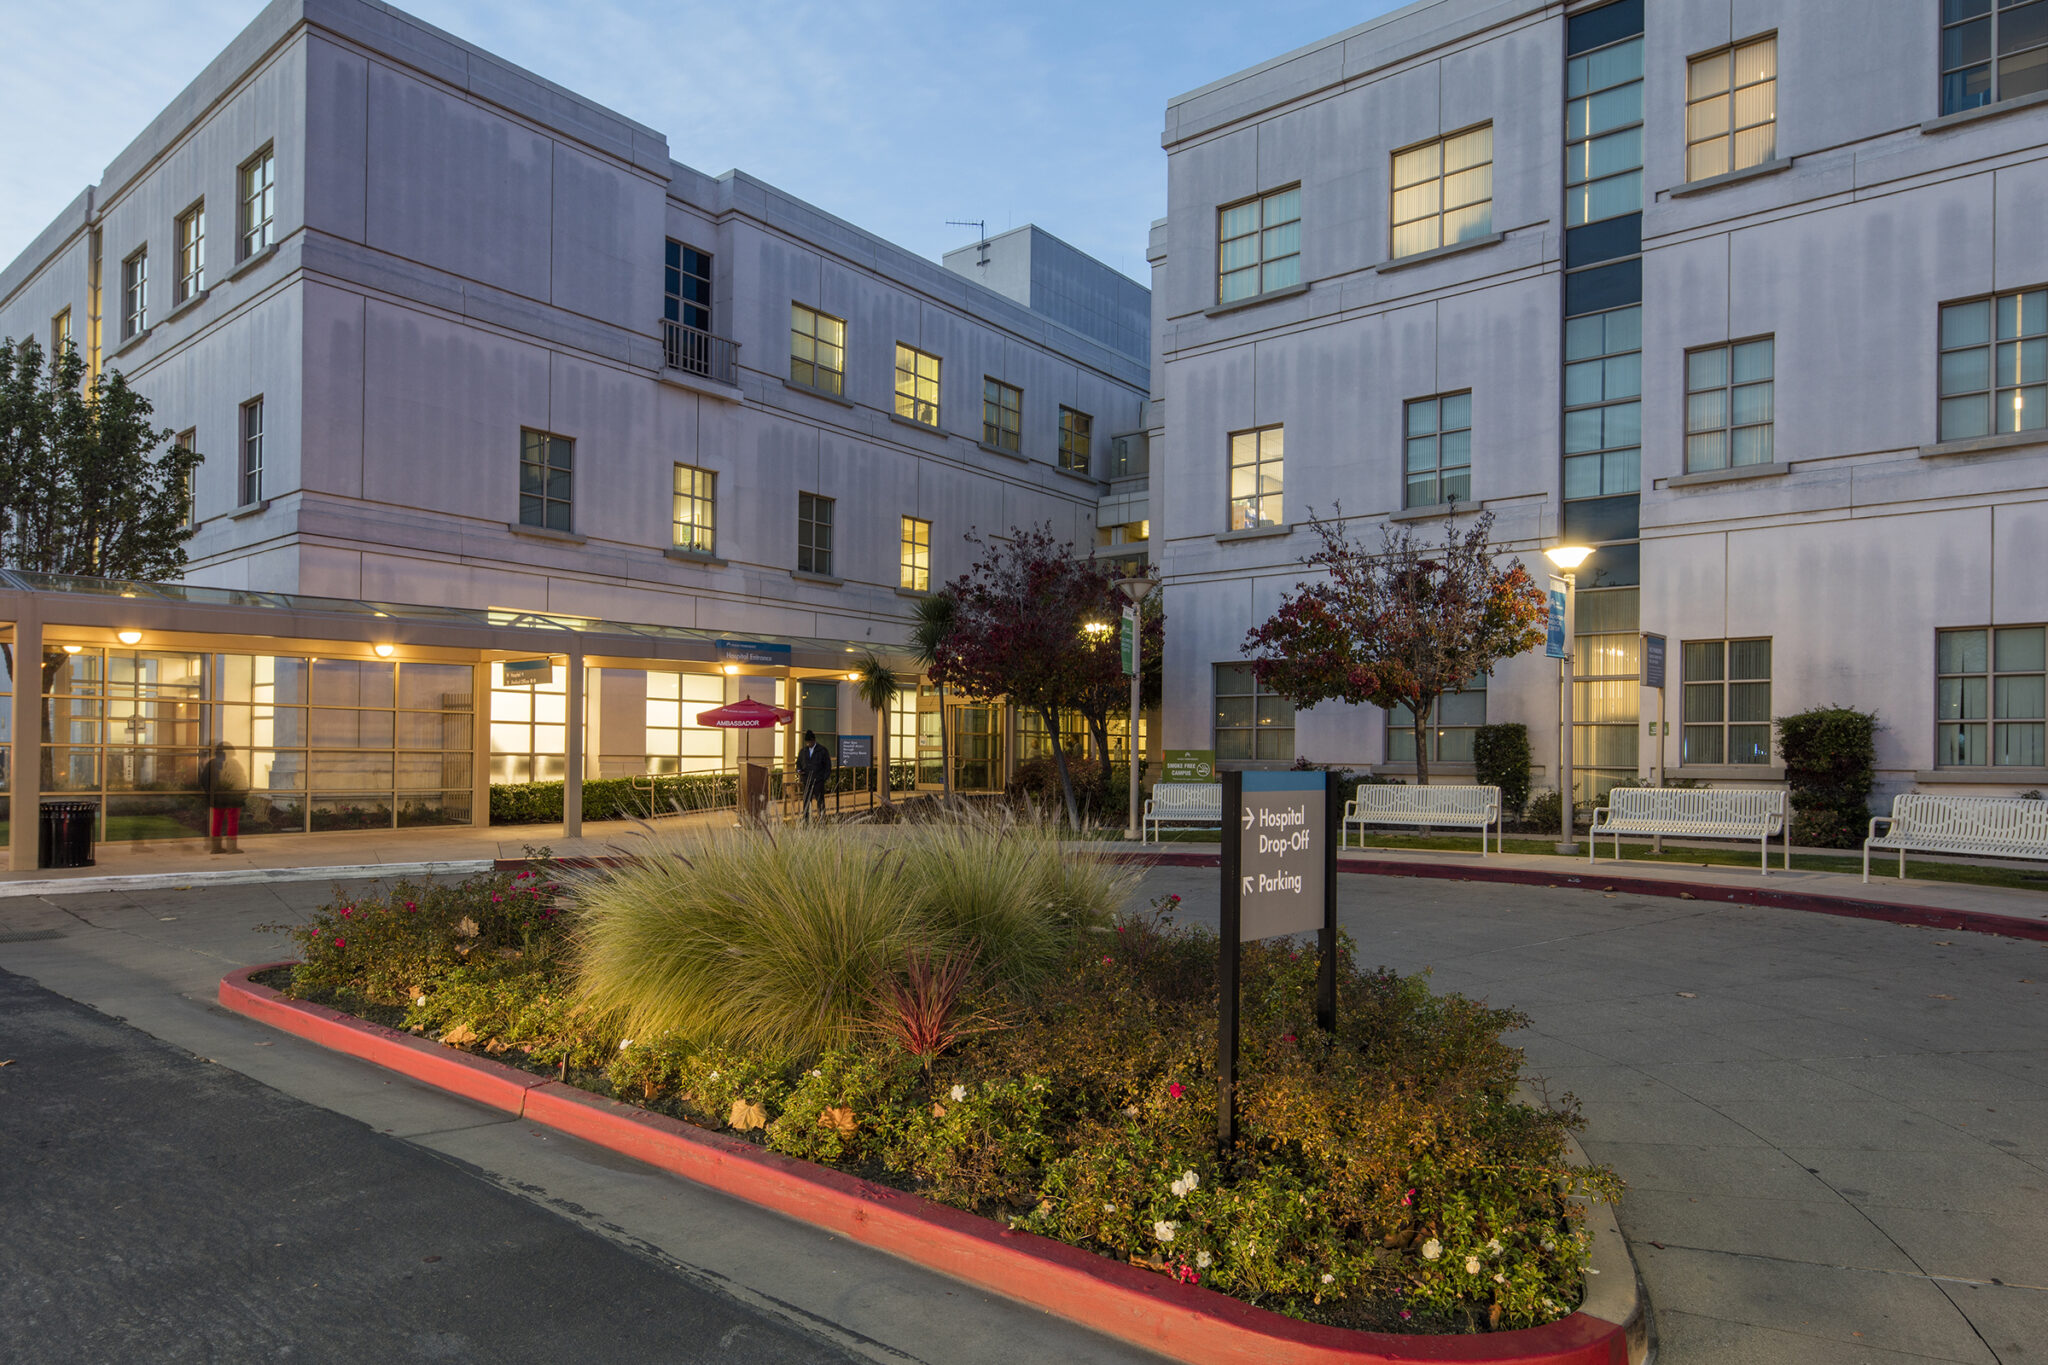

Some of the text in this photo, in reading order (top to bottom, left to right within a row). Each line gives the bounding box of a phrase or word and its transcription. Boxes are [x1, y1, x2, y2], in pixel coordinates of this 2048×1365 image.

[726, 652, 772, 661] Hospital Entrance
[1259, 804, 1305, 832] Hospital
[1259, 829, 1310, 858] Drop-Off
[1259, 869, 1302, 894] Parking
